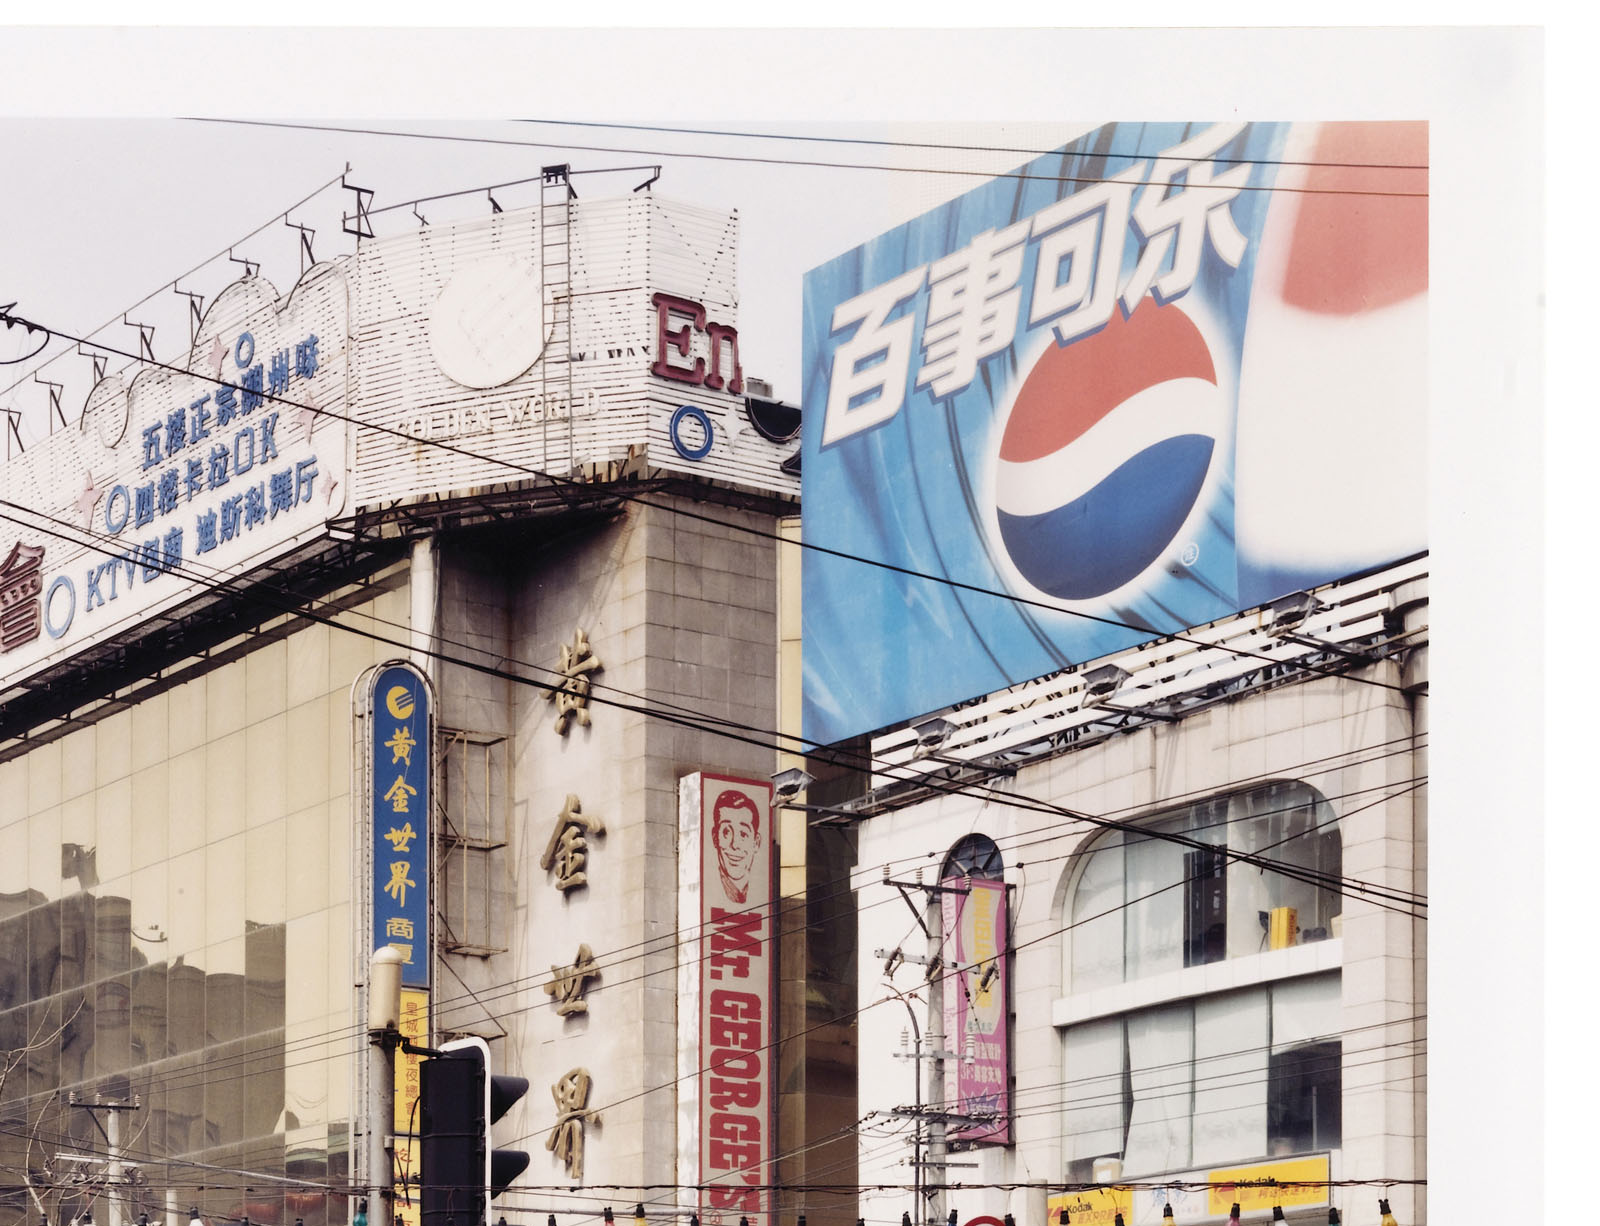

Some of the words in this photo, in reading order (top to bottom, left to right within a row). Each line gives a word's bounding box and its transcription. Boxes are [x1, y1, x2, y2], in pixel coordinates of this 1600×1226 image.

[820, 121, 1252, 453] 百事可乐
[710, 907, 763, 980] Mr.
[709, 987, 762, 1213] GEORGE'S
[1066, 1202, 1093, 1214] Kodak
